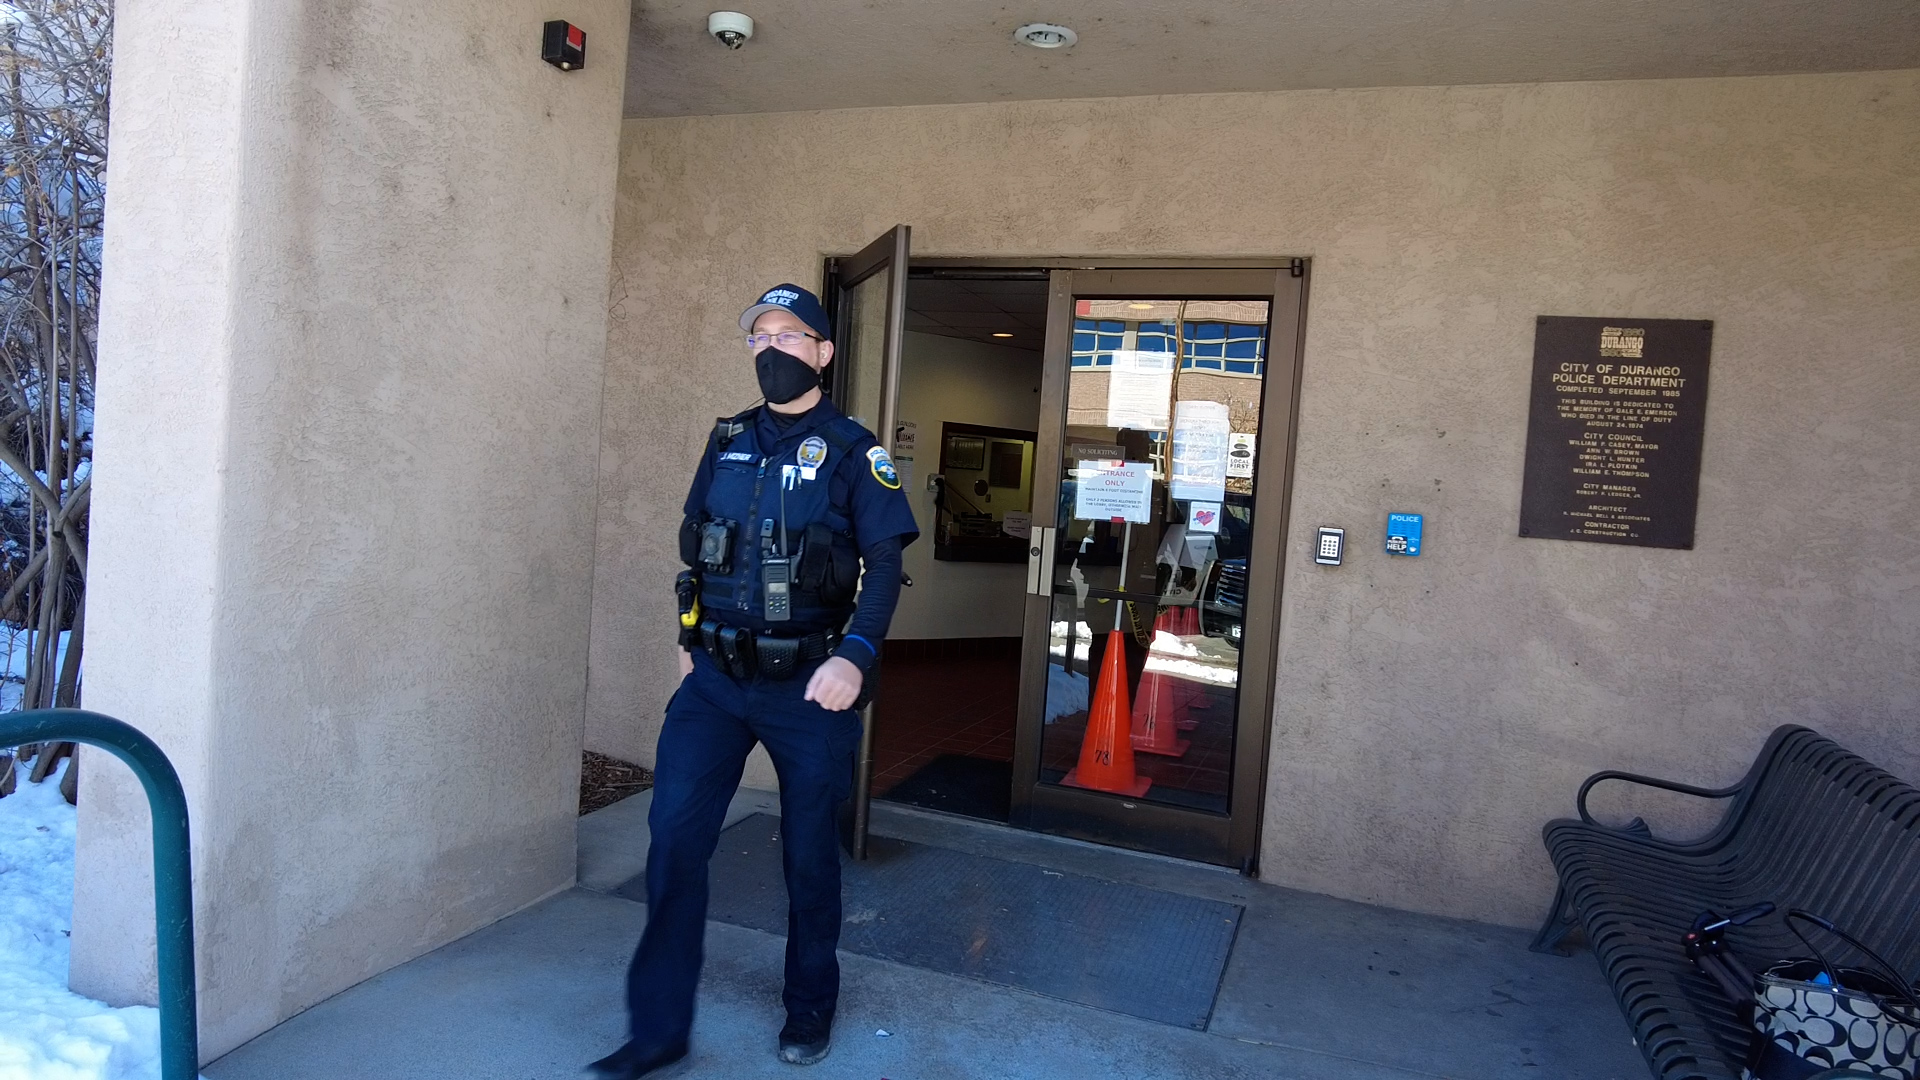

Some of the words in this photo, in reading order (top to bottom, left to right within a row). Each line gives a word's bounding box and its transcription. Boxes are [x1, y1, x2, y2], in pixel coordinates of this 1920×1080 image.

[766, 297, 793, 306] POLICE
[1601, 337, 1643, 349] DURANGO
[1561, 363, 1588, 372] CITY
[1596, 364, 1613, 373] OF
[1620, 366, 1680, 376] DURANGO
[1553, 374, 1595, 384] POLICE
[1603, 376, 1686, 387] DEPARTMENT
[1556, 385, 1603, 394] COMPLETED
[1609, 387, 1656, 396] SEPTEMBER
[1584, 432, 1603, 440] CITY
[1608, 433, 1643, 442] COUNCIL
[1097, 469, 1135, 477] NTRANCE
[1613, 470, 1649, 478] THOMPSON
[1603, 484, 1636, 492] MANAGER
[1588, 504, 1627, 512] ARCHITECT
[1585, 521, 1629, 530] CONTRACTOR
[1095, 750, 1109, 765] 78
